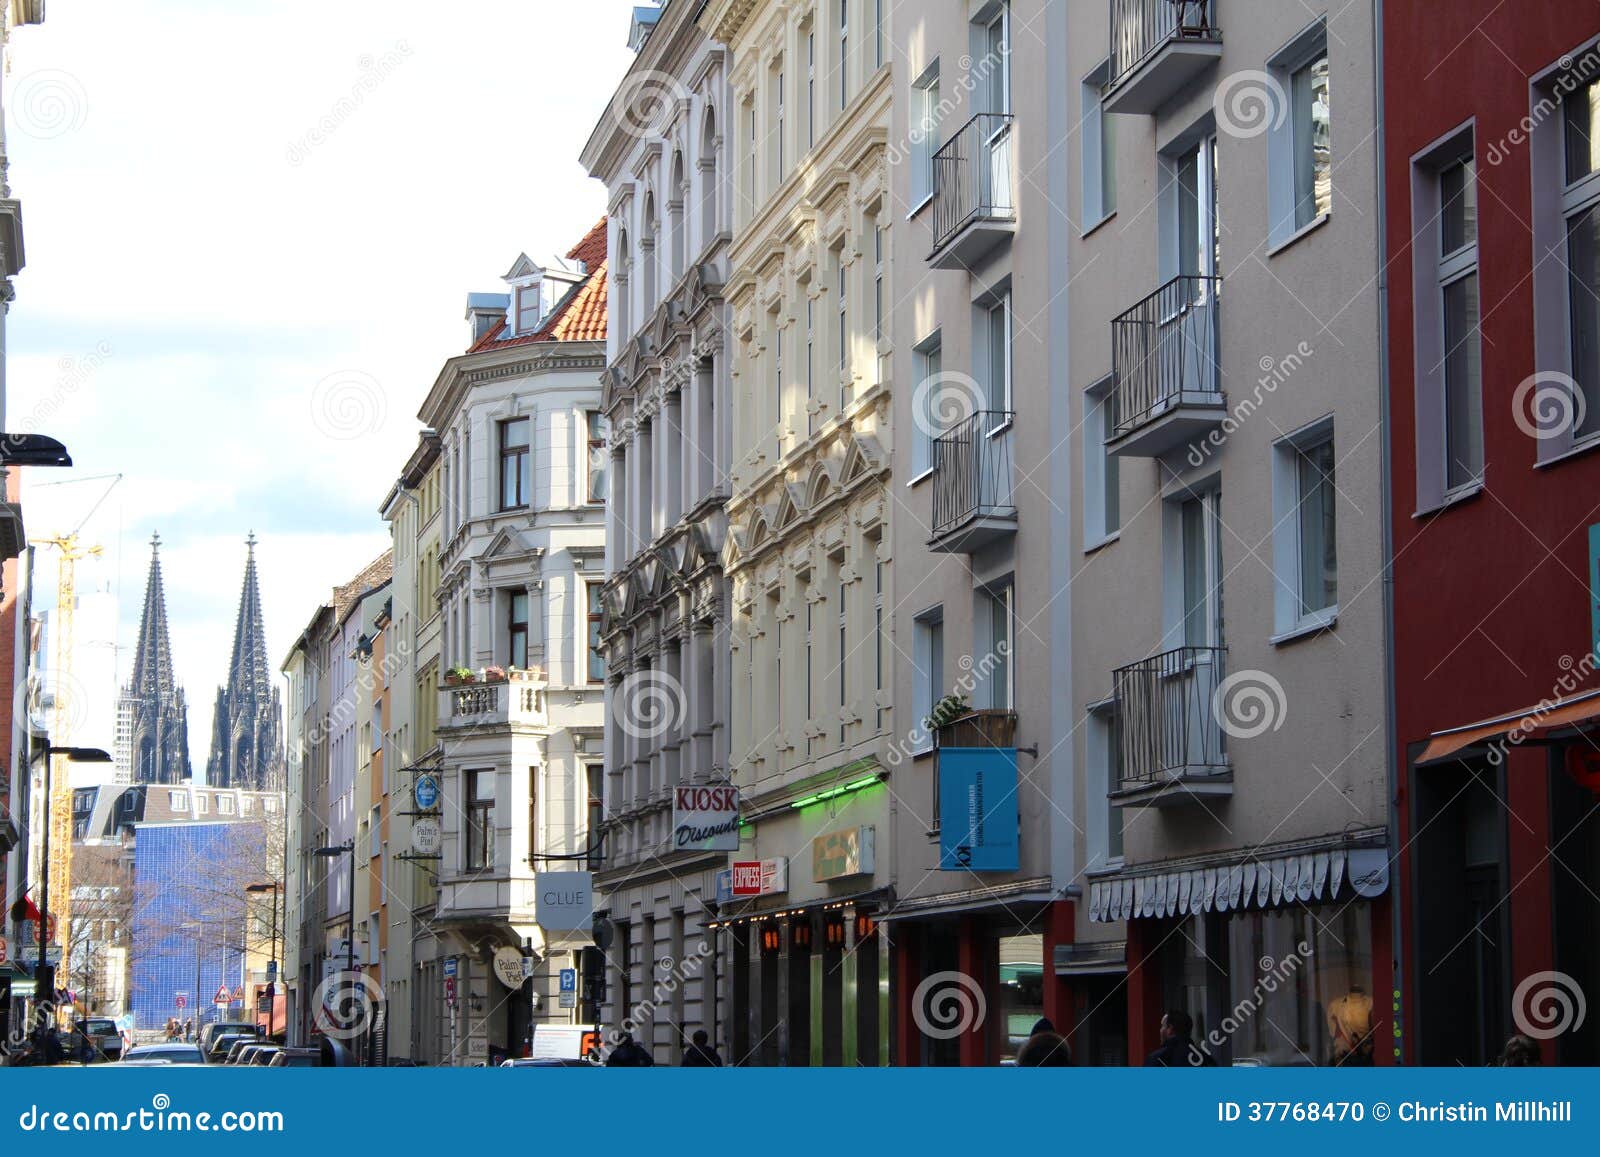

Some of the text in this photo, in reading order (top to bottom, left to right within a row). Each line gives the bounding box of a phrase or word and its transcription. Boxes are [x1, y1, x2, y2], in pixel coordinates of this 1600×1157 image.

[676, 787, 738, 812] KIOSK
[676, 815, 739, 846] Discount
[734, 866, 761, 888] EXPRESS
[543, 891, 585, 906] CLUE
